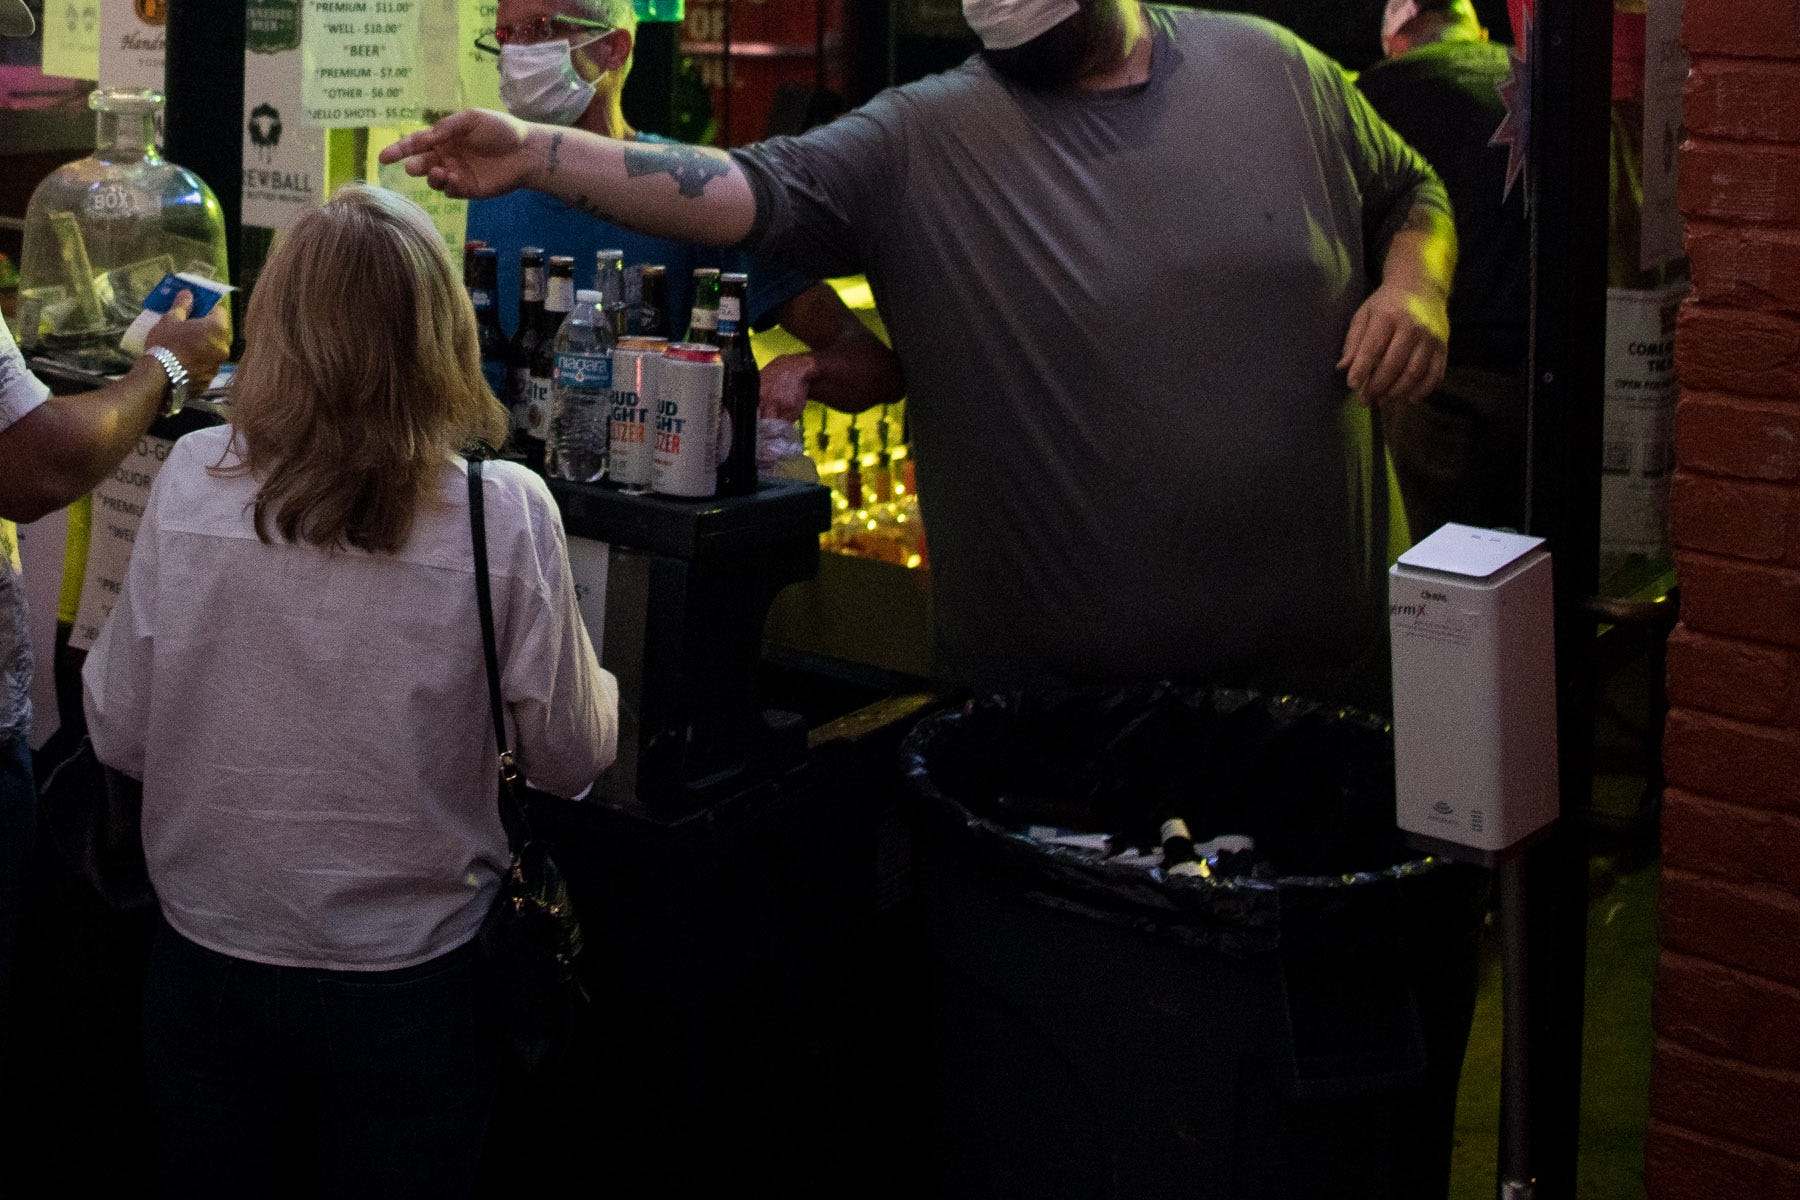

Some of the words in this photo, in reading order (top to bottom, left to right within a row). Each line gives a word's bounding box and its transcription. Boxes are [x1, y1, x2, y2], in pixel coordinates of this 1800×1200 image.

[243, 167, 312, 193] EWBALL
[613, 407, 649, 424] GHT
[656, 400, 678, 416] UD
